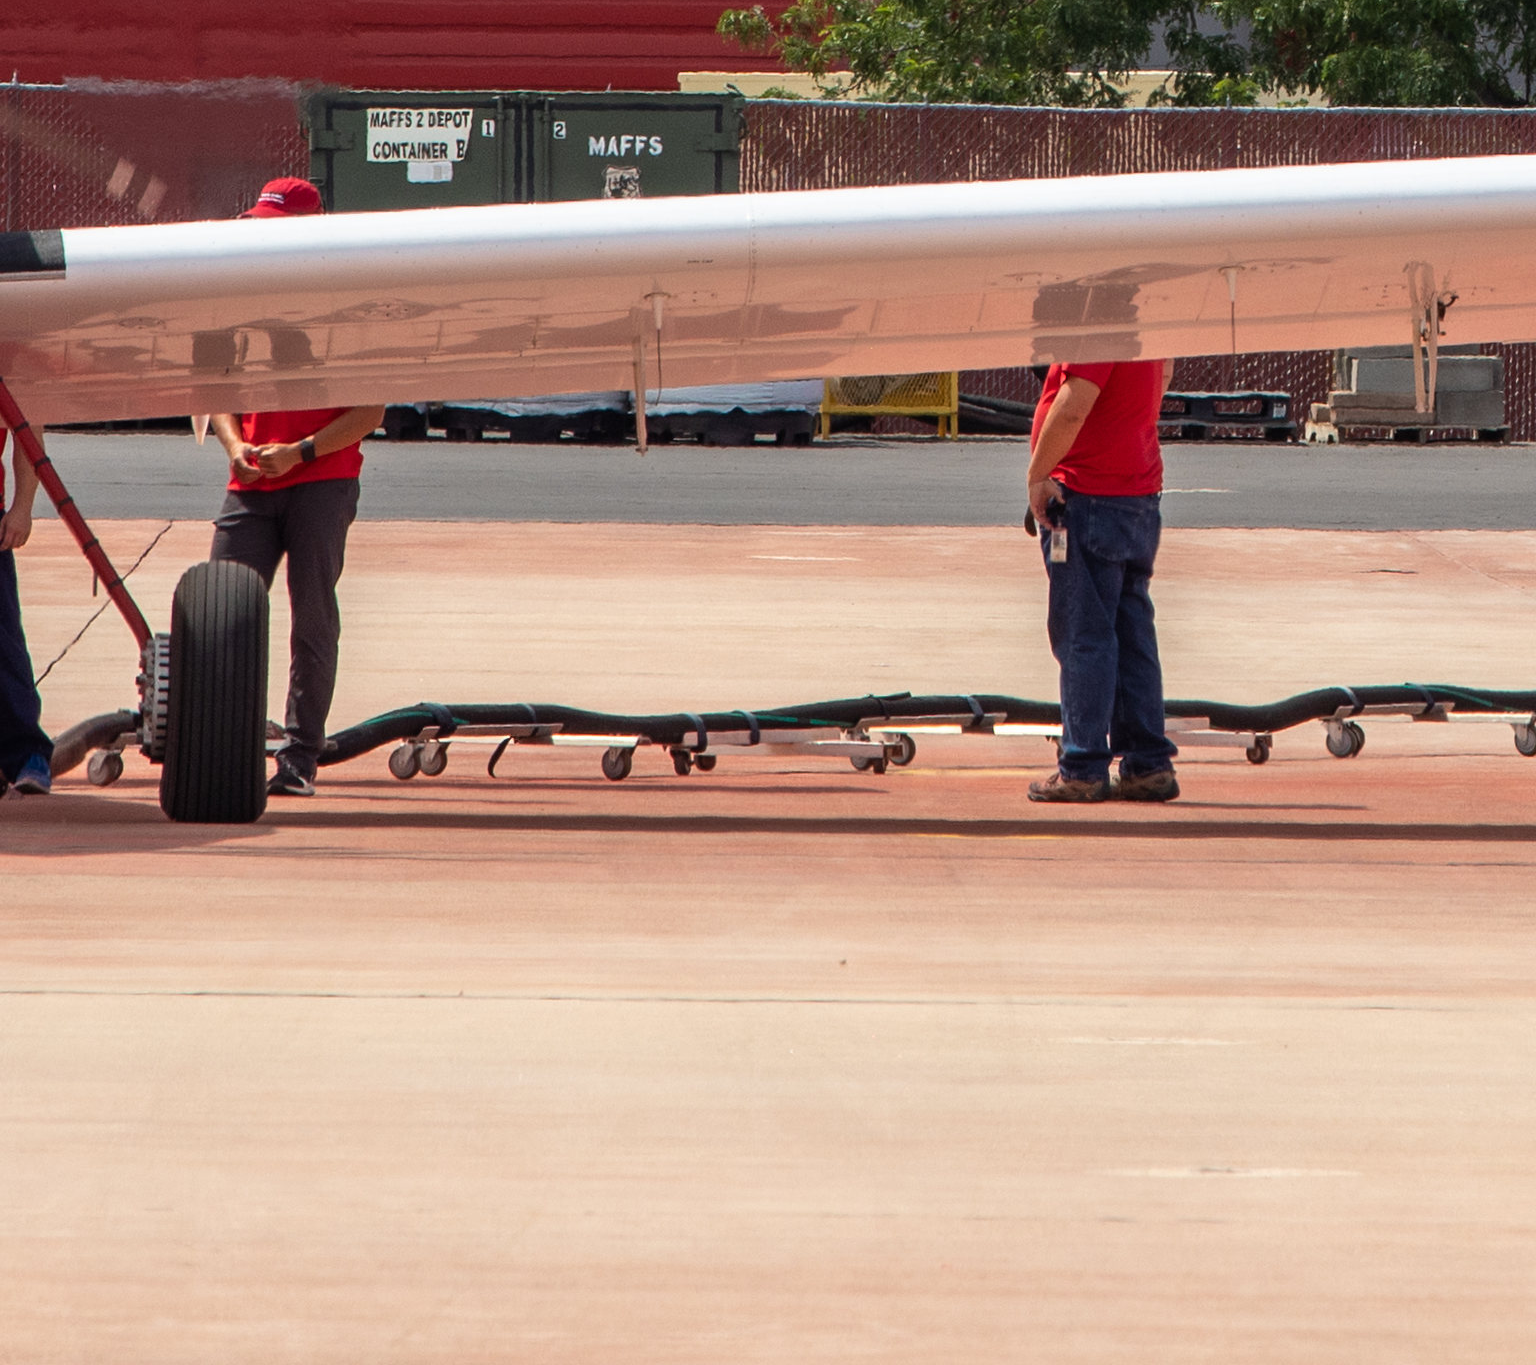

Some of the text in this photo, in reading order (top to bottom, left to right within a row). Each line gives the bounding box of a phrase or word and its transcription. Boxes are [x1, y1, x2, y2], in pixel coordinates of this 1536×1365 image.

[369, 110, 470, 128] MAFFS 2 DEPOT
[485, 121, 493, 136] 1
[555, 123, 564, 138] 2
[373, 141, 449, 159] CONTAINER
[588, 135, 663, 156] MAFFS
